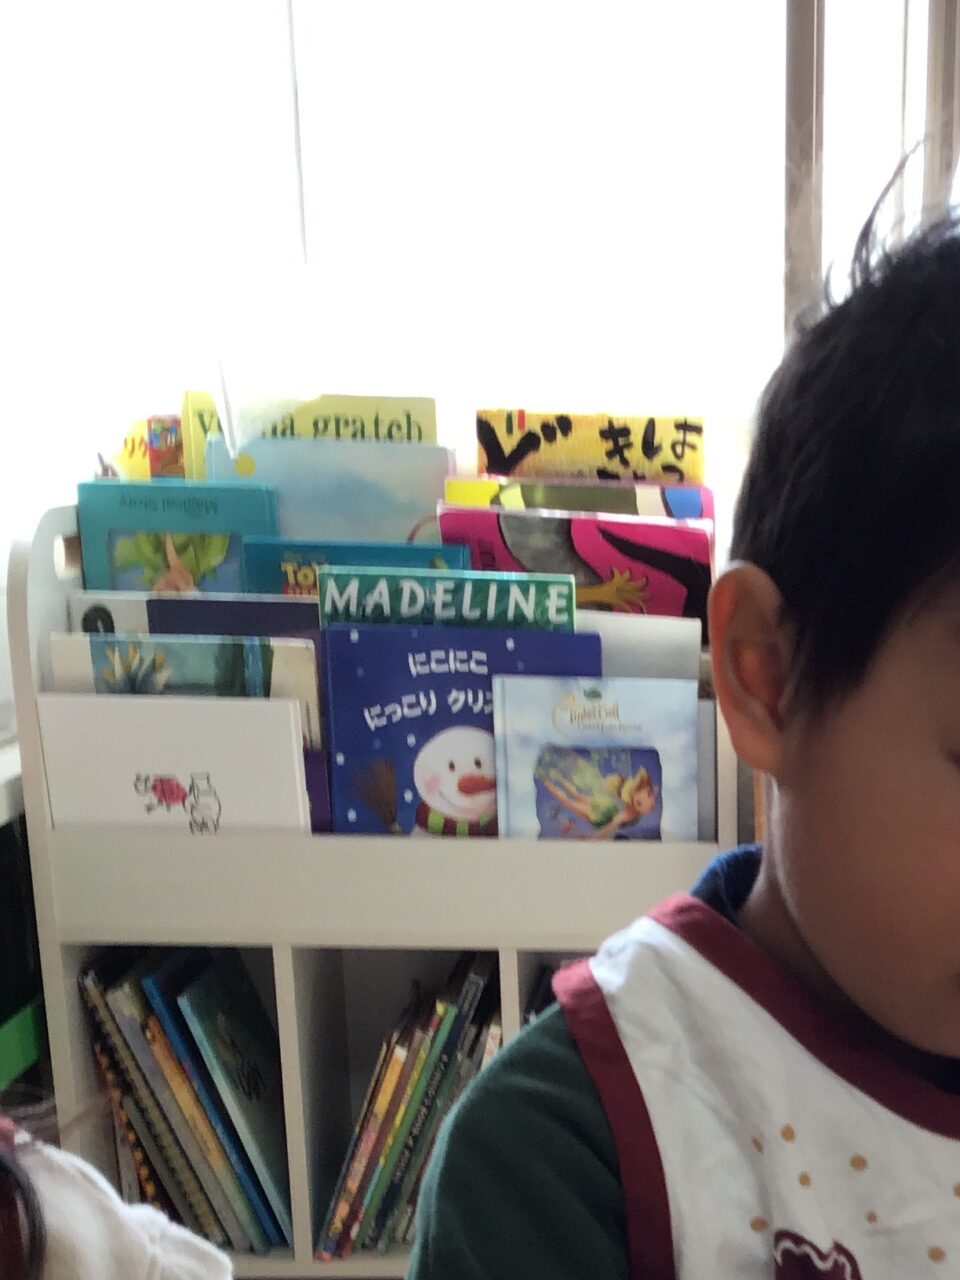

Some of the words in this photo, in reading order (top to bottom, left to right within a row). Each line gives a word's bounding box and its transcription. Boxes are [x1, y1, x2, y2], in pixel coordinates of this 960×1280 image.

[324, 576, 570, 624] MADELINE
[408, 648, 488, 678] にこにこ
